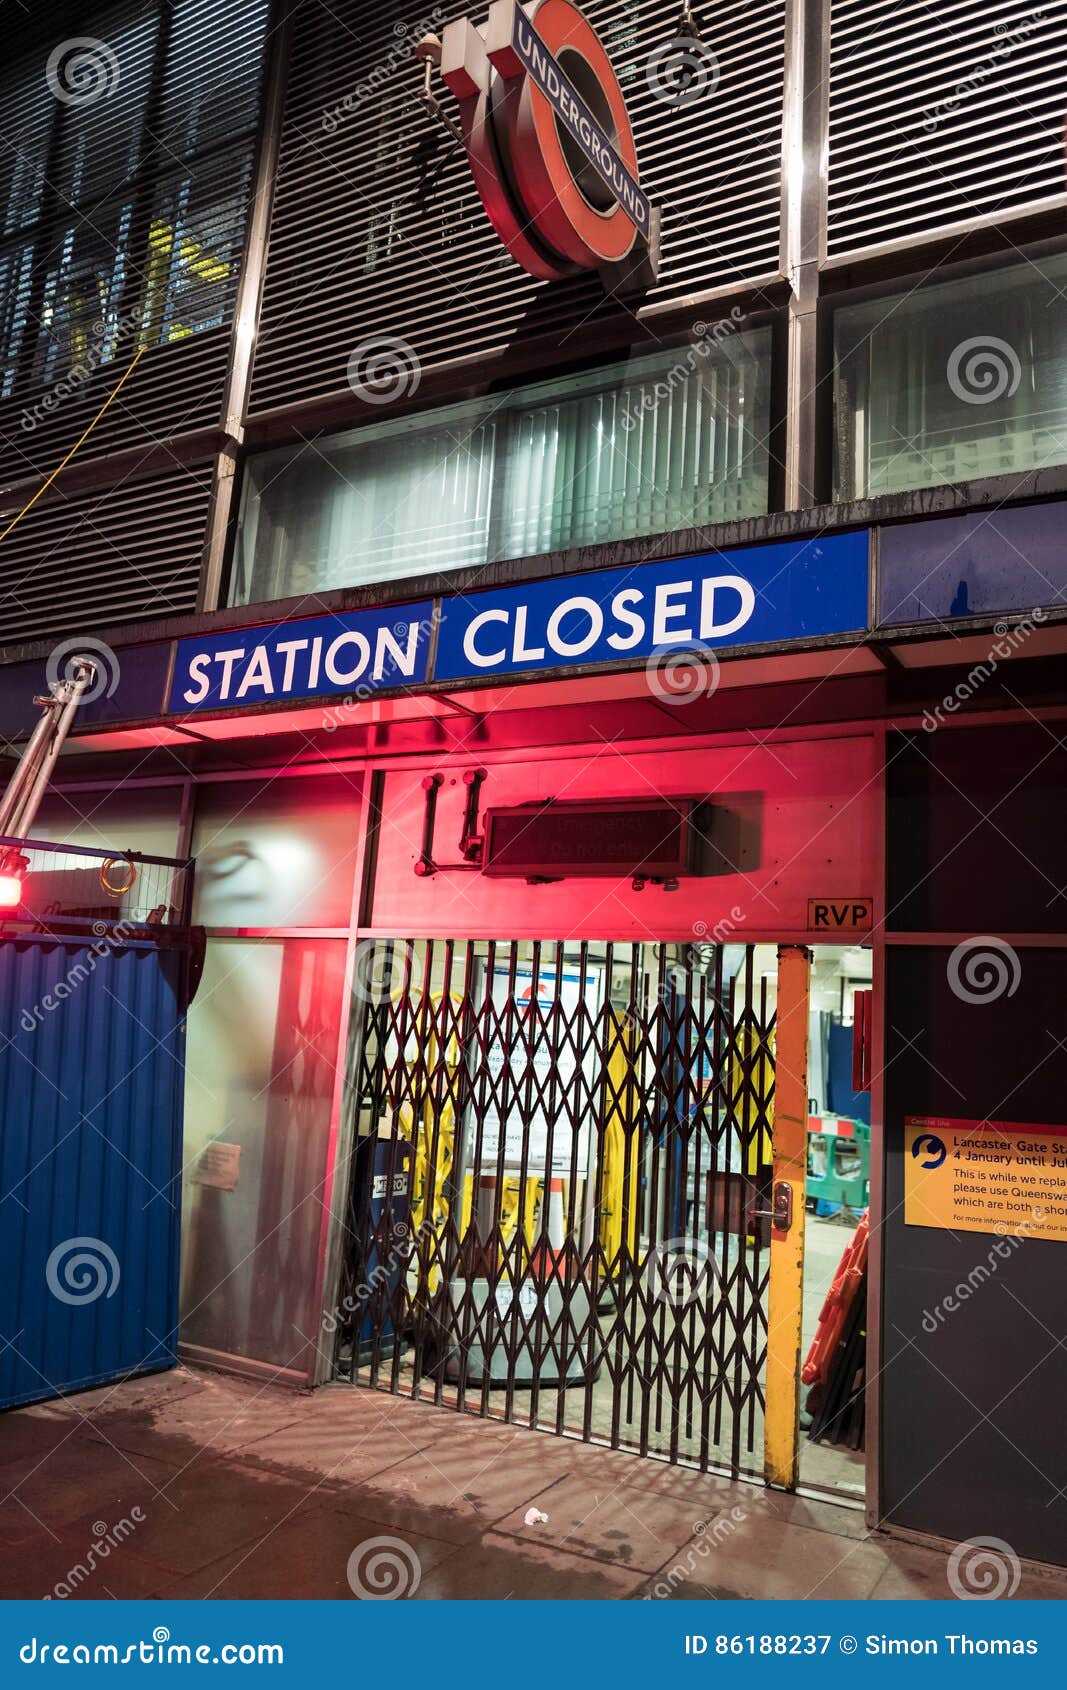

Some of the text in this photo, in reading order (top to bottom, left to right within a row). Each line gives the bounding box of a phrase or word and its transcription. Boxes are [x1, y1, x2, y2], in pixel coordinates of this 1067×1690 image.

[518, 21, 646, 223] UNDERGROUND
[183, 575, 755, 704] STATION CLOSED
[815, 904, 867, 926] RVP
[953, 1136, 1012, 1150] Lancaster
[1016, 1141, 1048, 1153] Gate
[953, 1151, 961, 1160] 4
[965, 1151, 1012, 1166] January
[1016, 1156, 1046, 1167] until
[953, 1168, 975, 1179] This
[978, 1170, 987, 1180] is
[989, 1172, 1018, 1183] while
[1020, 1176, 1037, 1185] we
[953, 1183, 987, 1194] please
[989, 1187, 1009, 1196] use
[953, 1197, 985, 1208] which
[987, 1201, 1004, 1210] are
[1006, 1200, 1032, 1212] both
